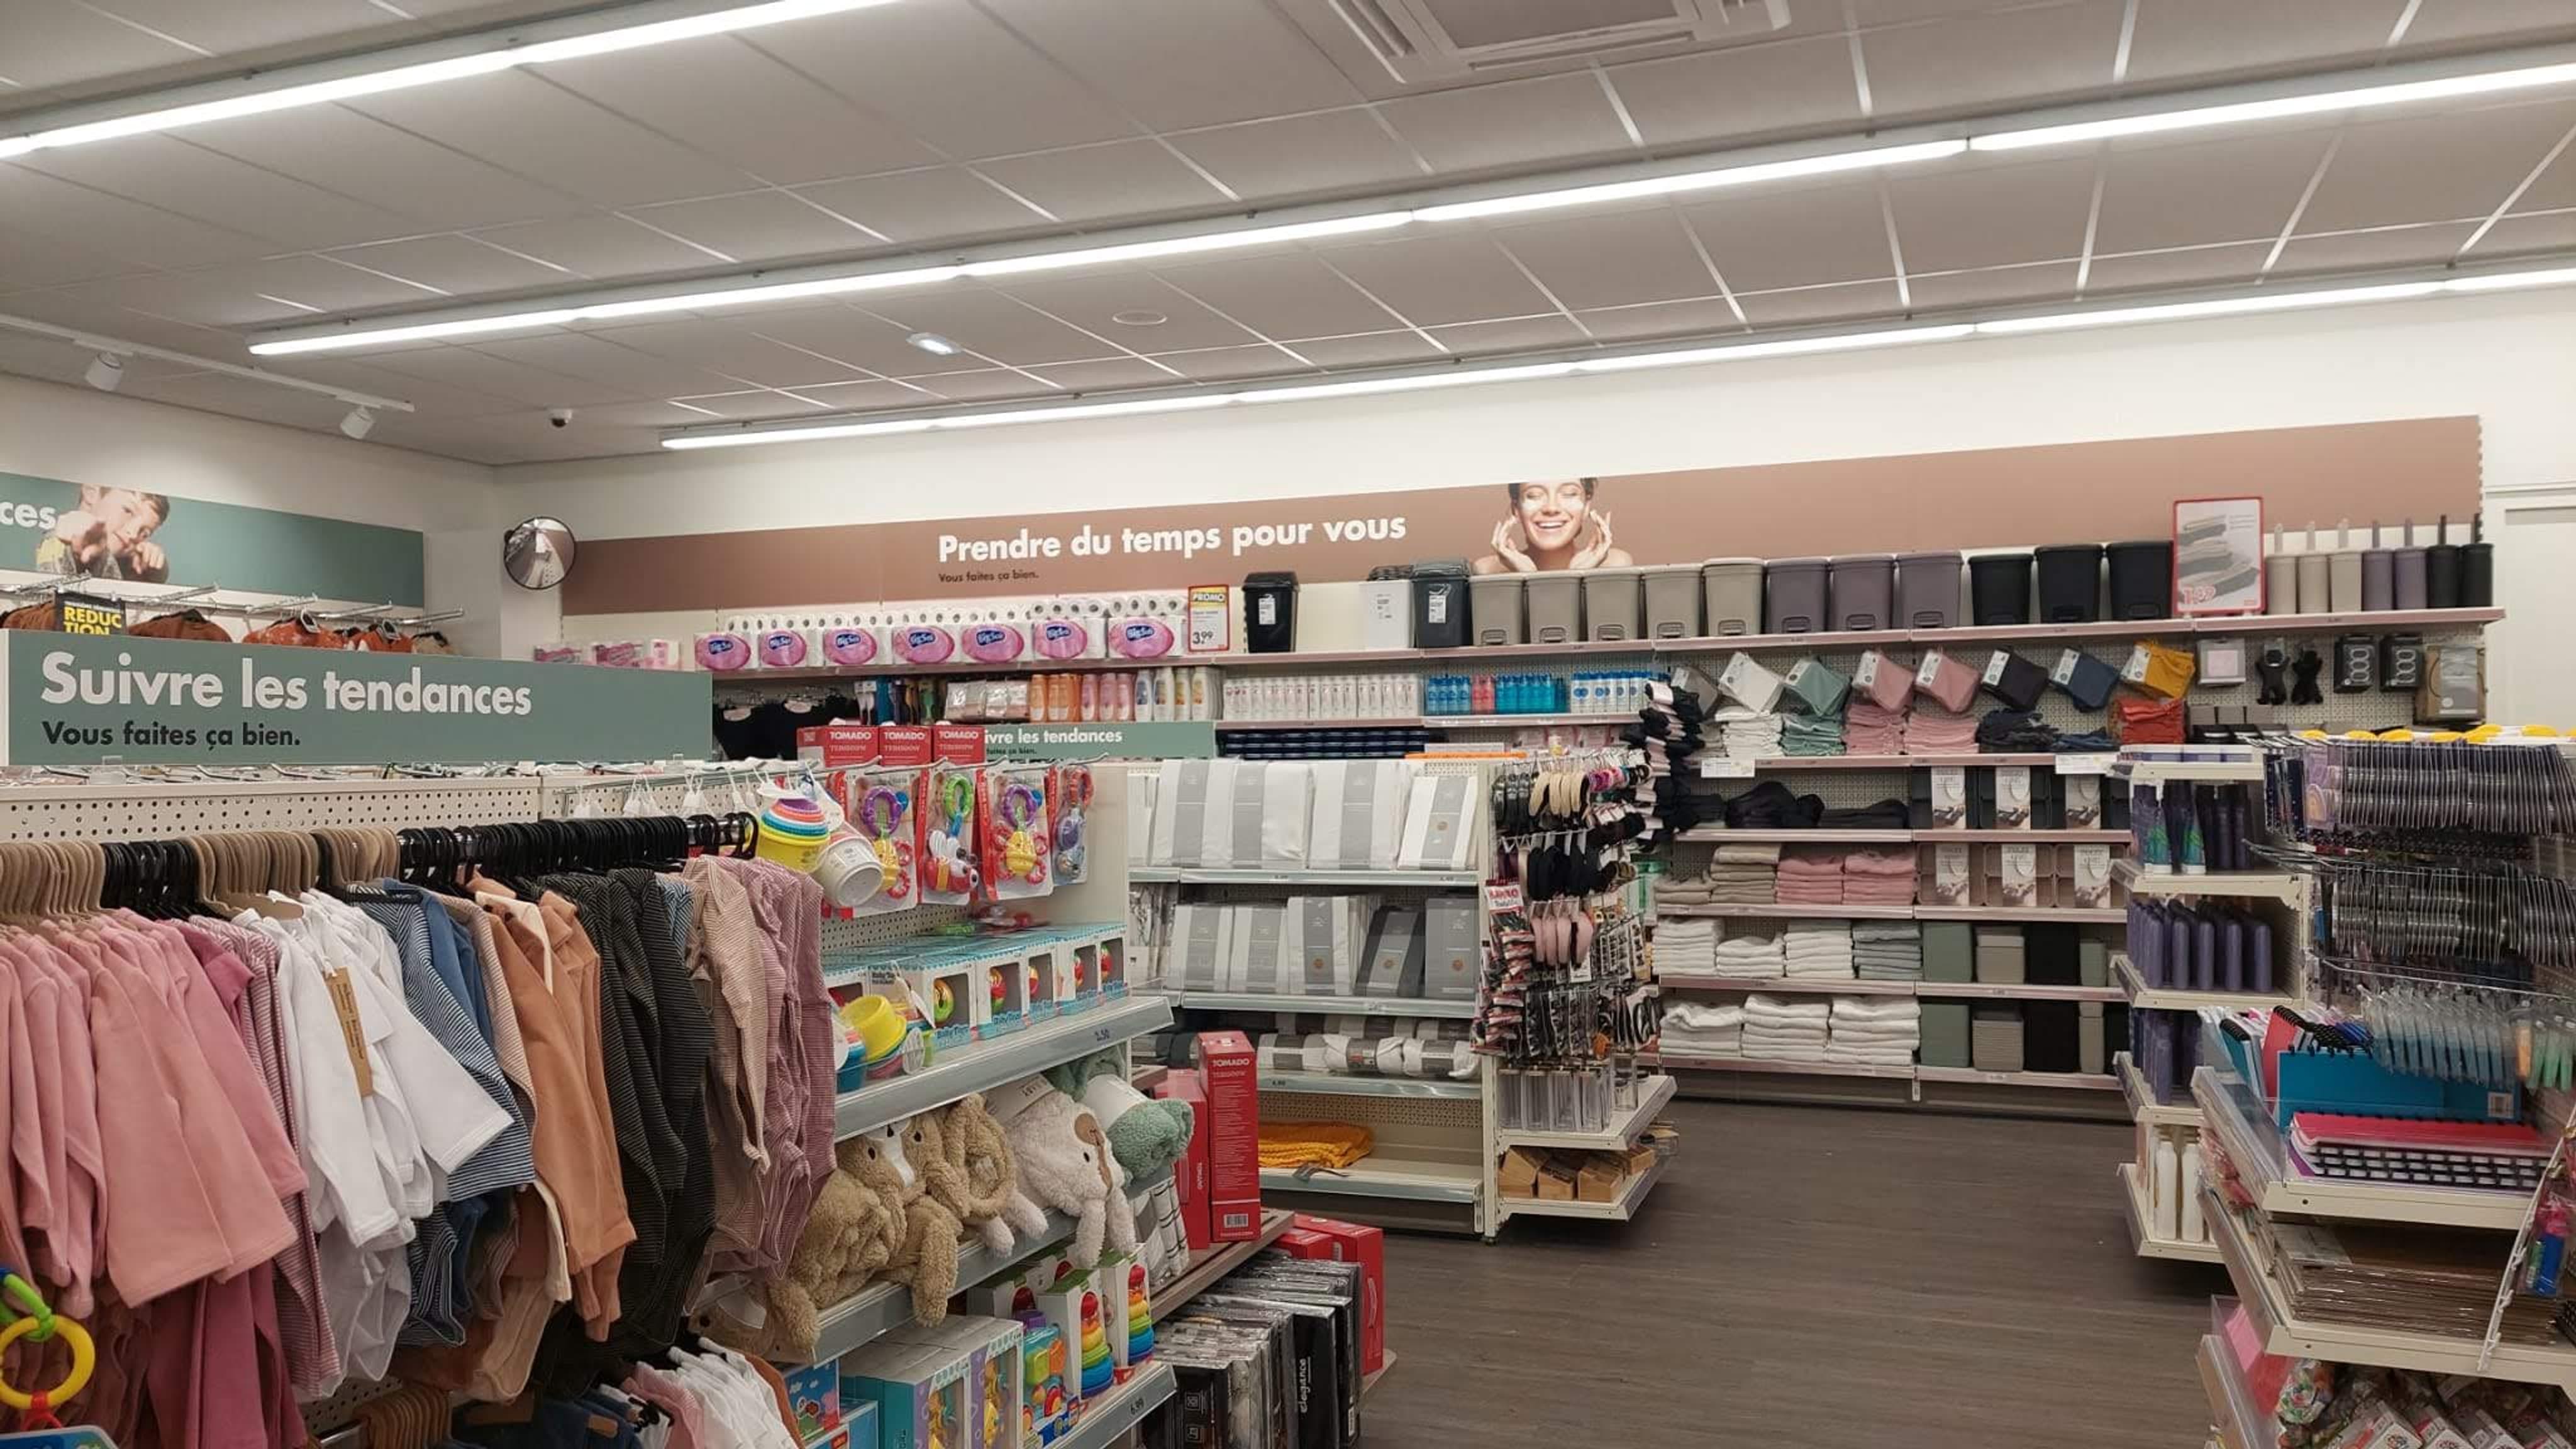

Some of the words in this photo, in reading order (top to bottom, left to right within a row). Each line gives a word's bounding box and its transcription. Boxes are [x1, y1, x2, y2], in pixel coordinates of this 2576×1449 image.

[938, 528, 1062, 562] Prendre
[1070, 525, 1111, 556] du
[1122, 527, 1221, 558] temps
[1233, 523, 1313, 555] pour
[1323, 516, 1407, 542] vous
[938, 572, 963, 583] Vous
[965, 570, 995, 582] faites
[1012, 569, 1040, 580] bien.
[64, 606, 122, 629] REDUC
[1192, 631, 1214, 645] 3.99
[41, 651, 224, 708] Suivre
[242, 657, 308, 709] les
[323, 666, 533, 716] tendances
[42, 721, 113, 746] Vous
[123, 720, 197, 746] faites
[206, 729, 233, 751] ça
[242, 722, 301, 746] bien.
[830, 731, 872, 740] TOMADO
[884, 731, 926, 740] TOMADO
[939, 730, 979, 740] TOMADO
[1018, 728, 1039, 743] les
[1043, 727, 1123, 743] tendances
[1213, 1058, 1250, 1067] TOMADO
